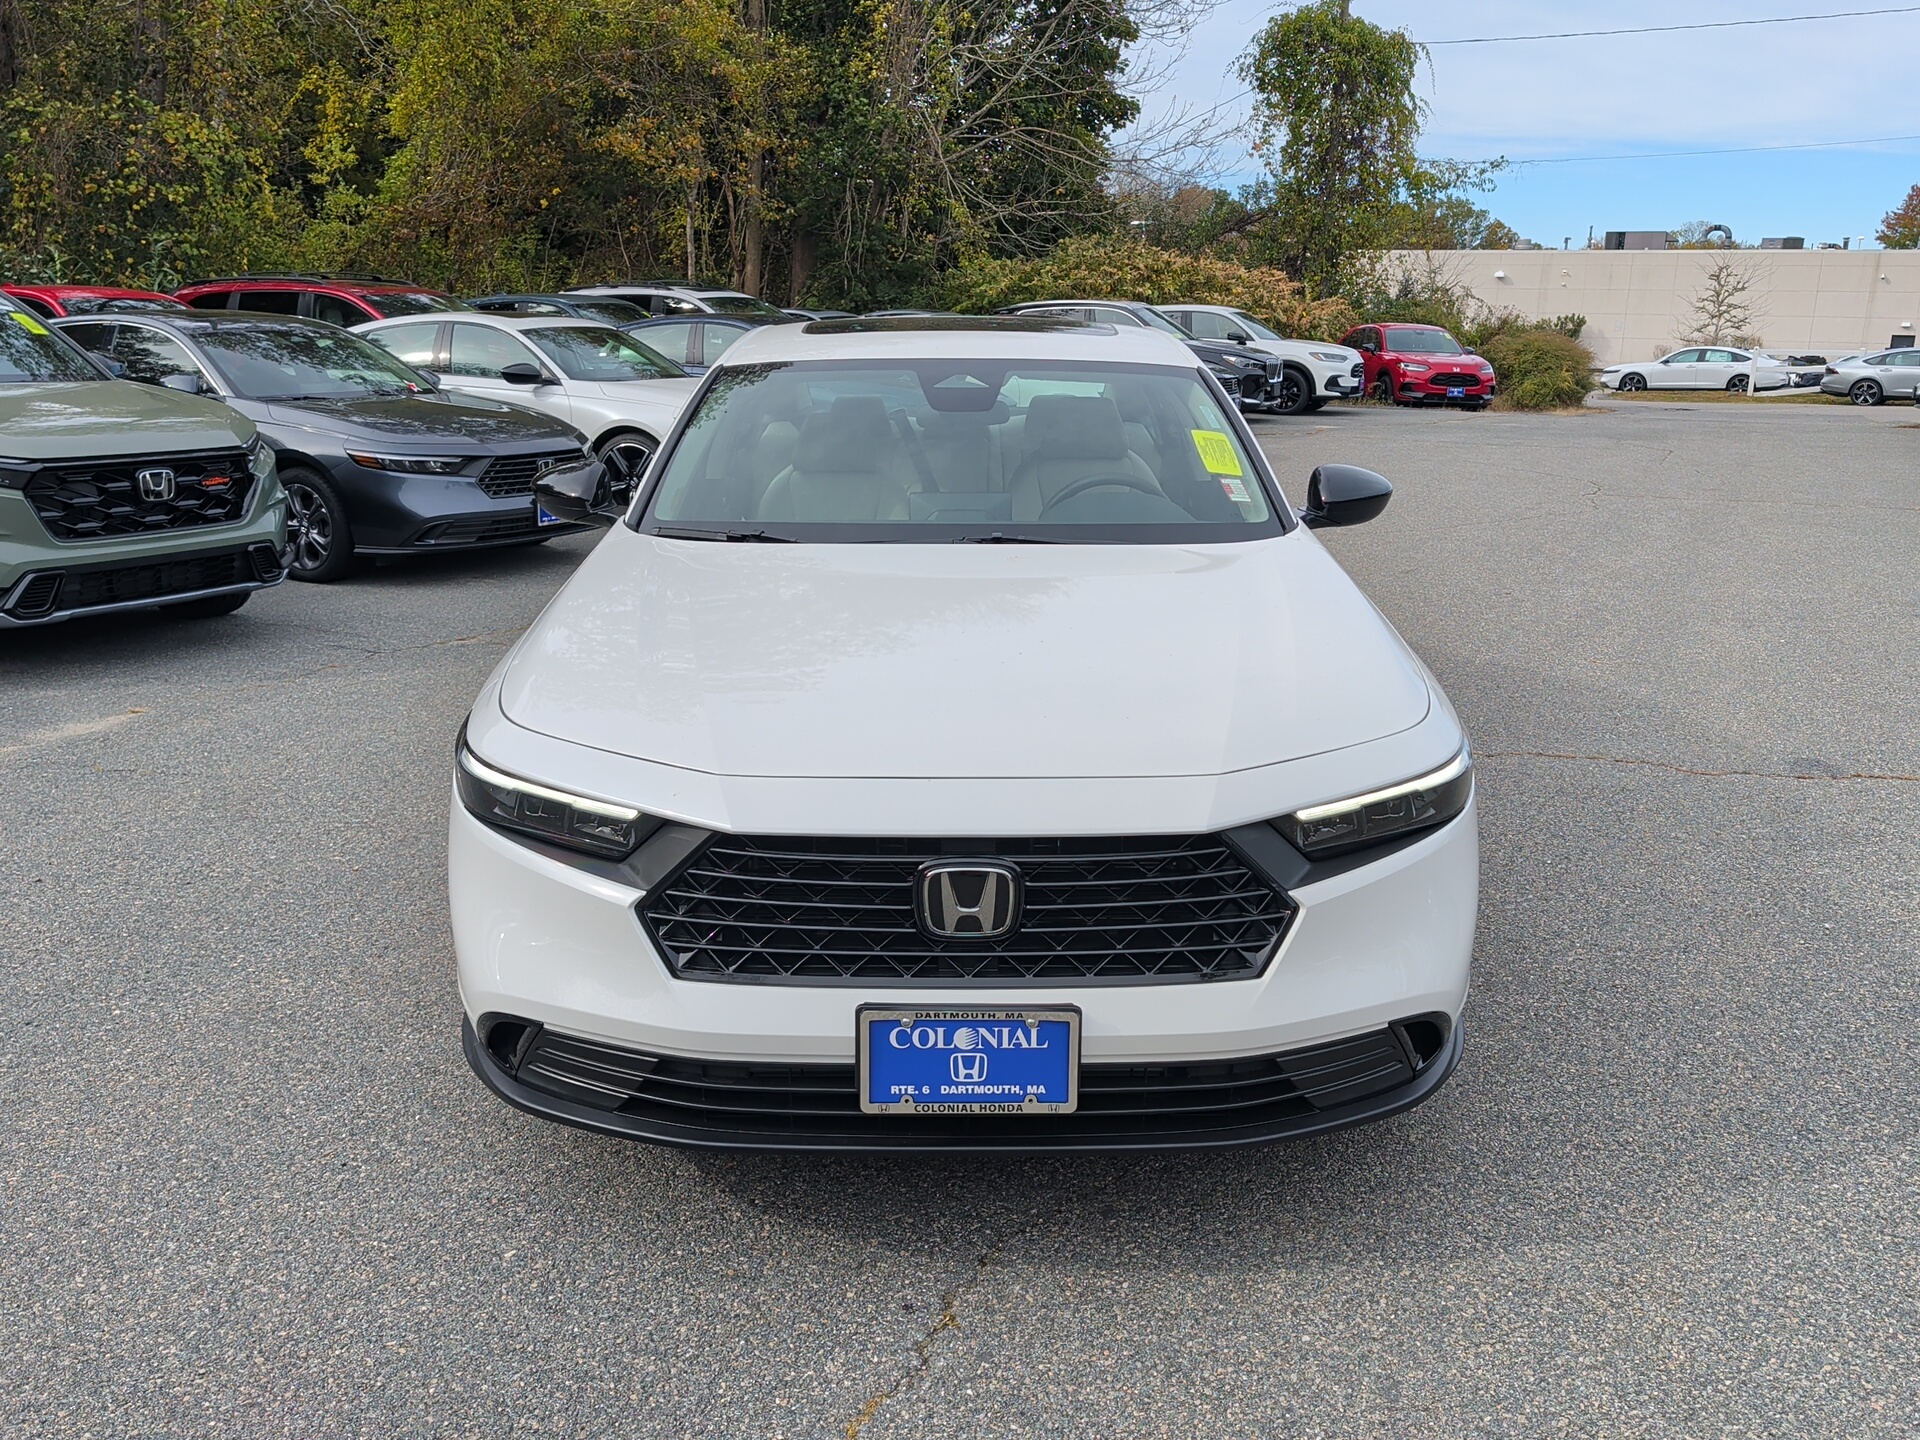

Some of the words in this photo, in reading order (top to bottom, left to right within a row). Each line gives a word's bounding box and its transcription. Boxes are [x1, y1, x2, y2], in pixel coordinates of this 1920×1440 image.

[889, 1026, 1049, 1050] COLONIAL
[890, 1085, 919, 1095] RTE.
[922, 1085, 930, 1095] 6
[940, 1085, 1024, 1096] DARTMOUTH,
[1027, 1085, 1046, 1094] MA
[914, 1104, 976, 1113] COLONIAL
[979, 1104, 1024, 1113] HONDA
